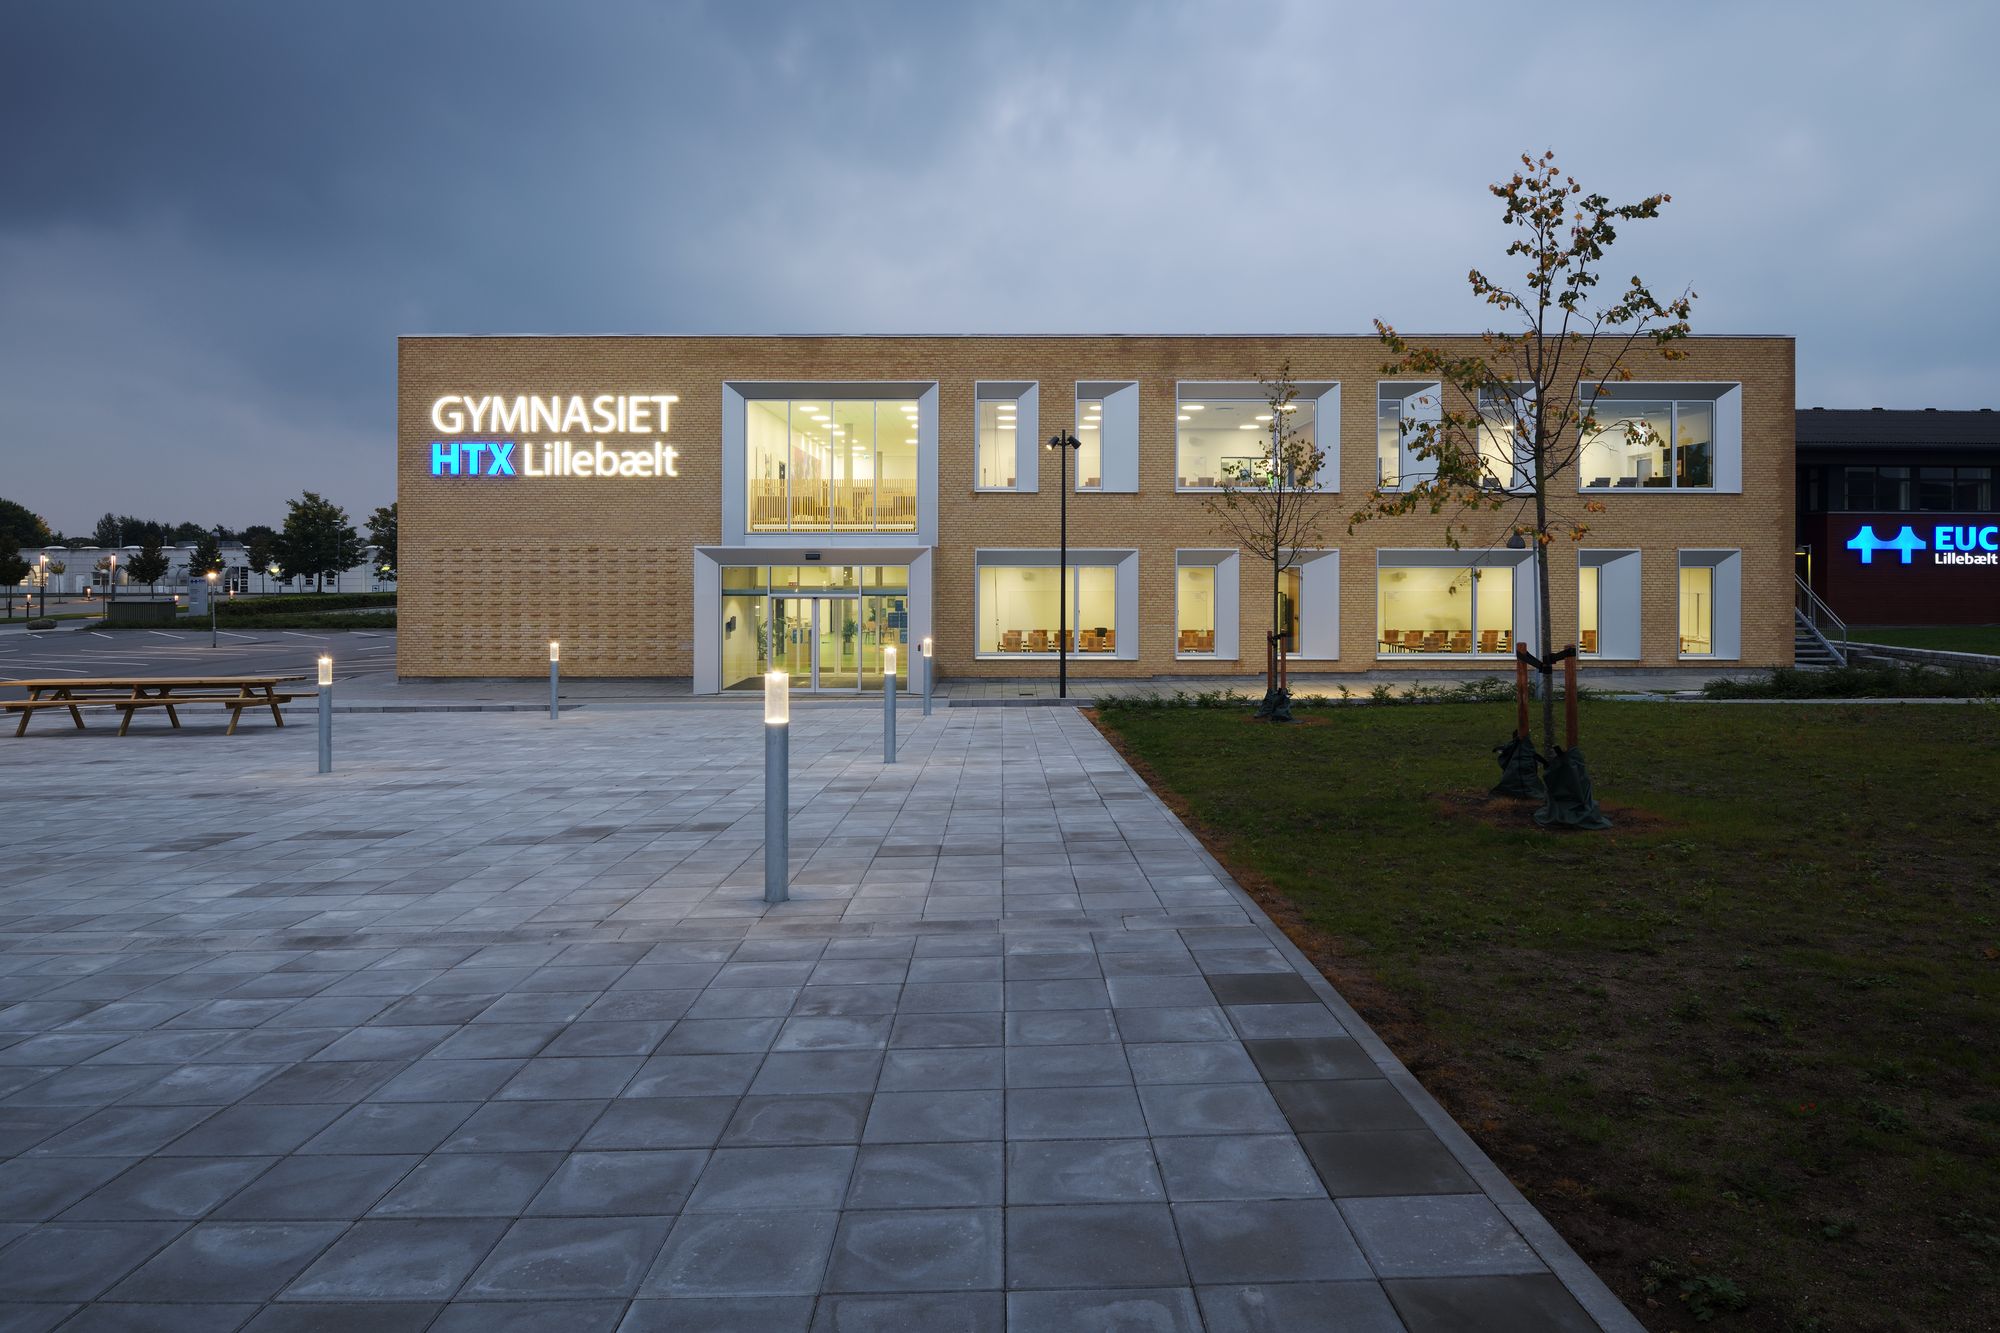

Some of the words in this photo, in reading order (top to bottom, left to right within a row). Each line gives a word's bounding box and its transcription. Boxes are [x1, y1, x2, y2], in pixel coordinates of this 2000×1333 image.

[431, 395, 679, 433] GYMNASIET
[431, 442, 516, 475] HTX
[523, 441, 679, 477] Lillebælt
[1935, 526, 1998, 551] EUC
[1935, 552, 1998, 565] Lillebælt
